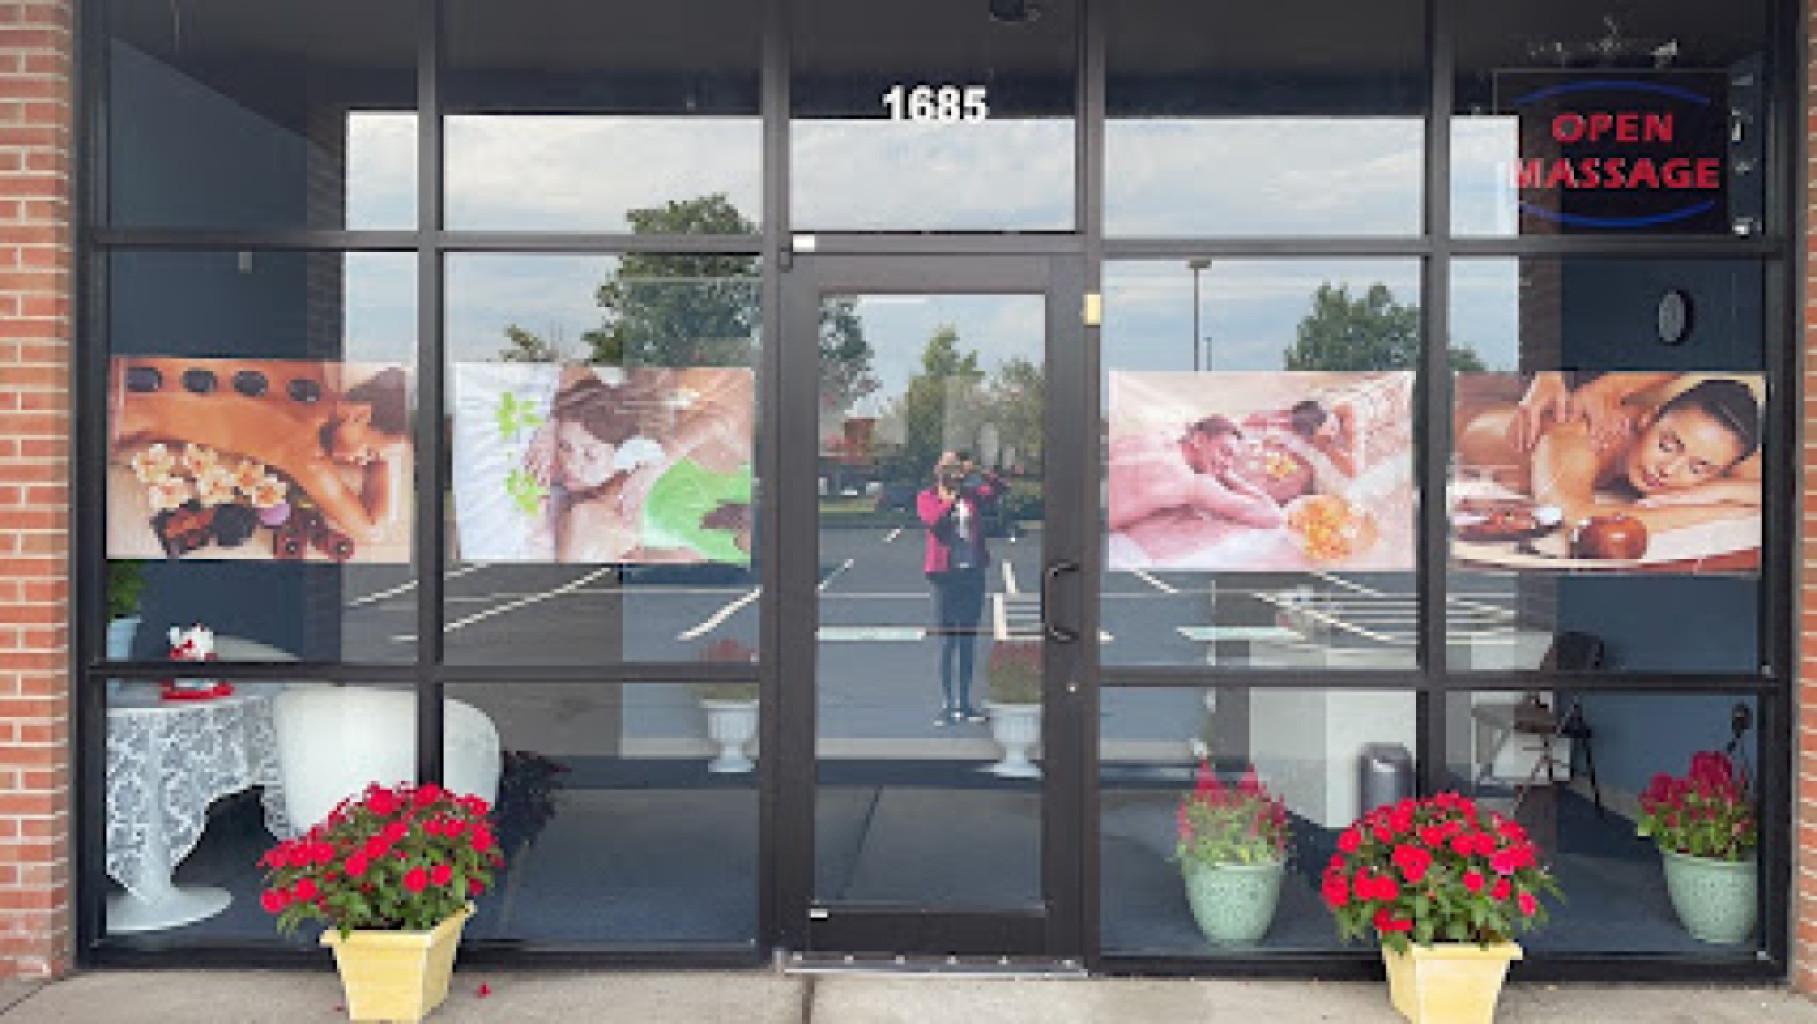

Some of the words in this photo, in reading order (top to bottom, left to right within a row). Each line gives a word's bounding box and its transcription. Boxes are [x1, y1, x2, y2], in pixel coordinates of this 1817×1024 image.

[882, 84, 989, 124] 1685
[1552, 113, 1673, 141] OPEN
[1510, 158, 1720, 188] MASSAGE
